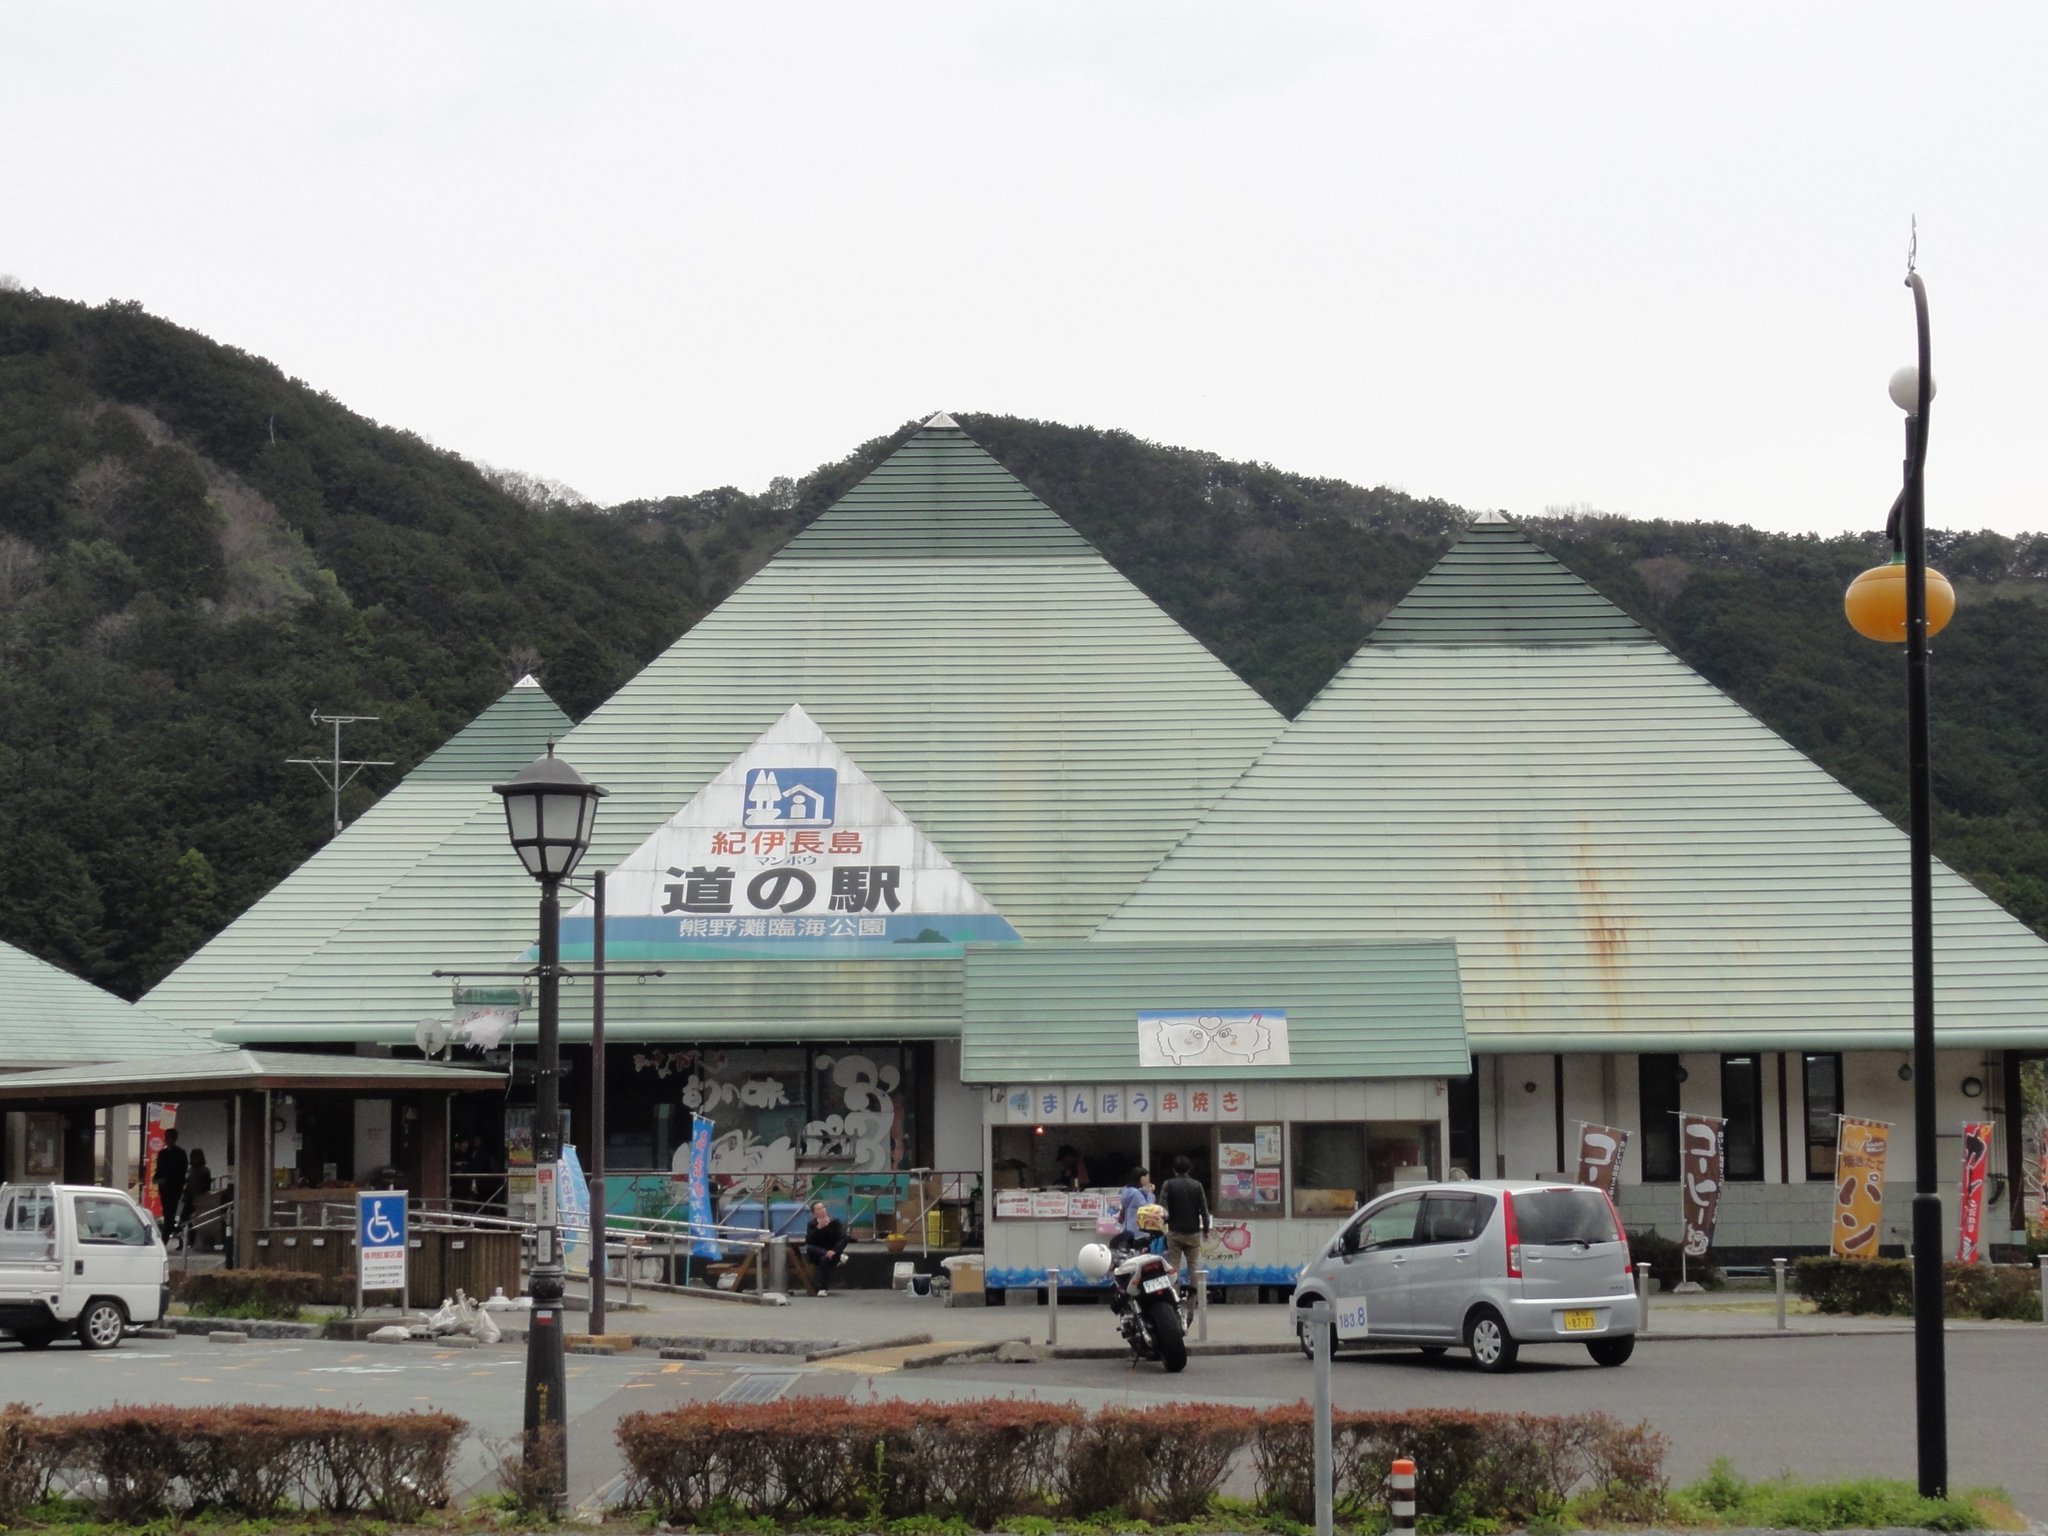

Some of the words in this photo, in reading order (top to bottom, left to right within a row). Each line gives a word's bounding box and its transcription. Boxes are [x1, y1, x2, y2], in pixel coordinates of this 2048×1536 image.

[711, 831, 863, 855] 紀伊長島
[661, 866, 901, 914] 道の駅
[679, 918, 886, 937] 熊野灘臨海公園
[1041, 1092, 1239, 1114] まんぼう串焼き
[1685, 1124, 1717, 1225] コーヒー
